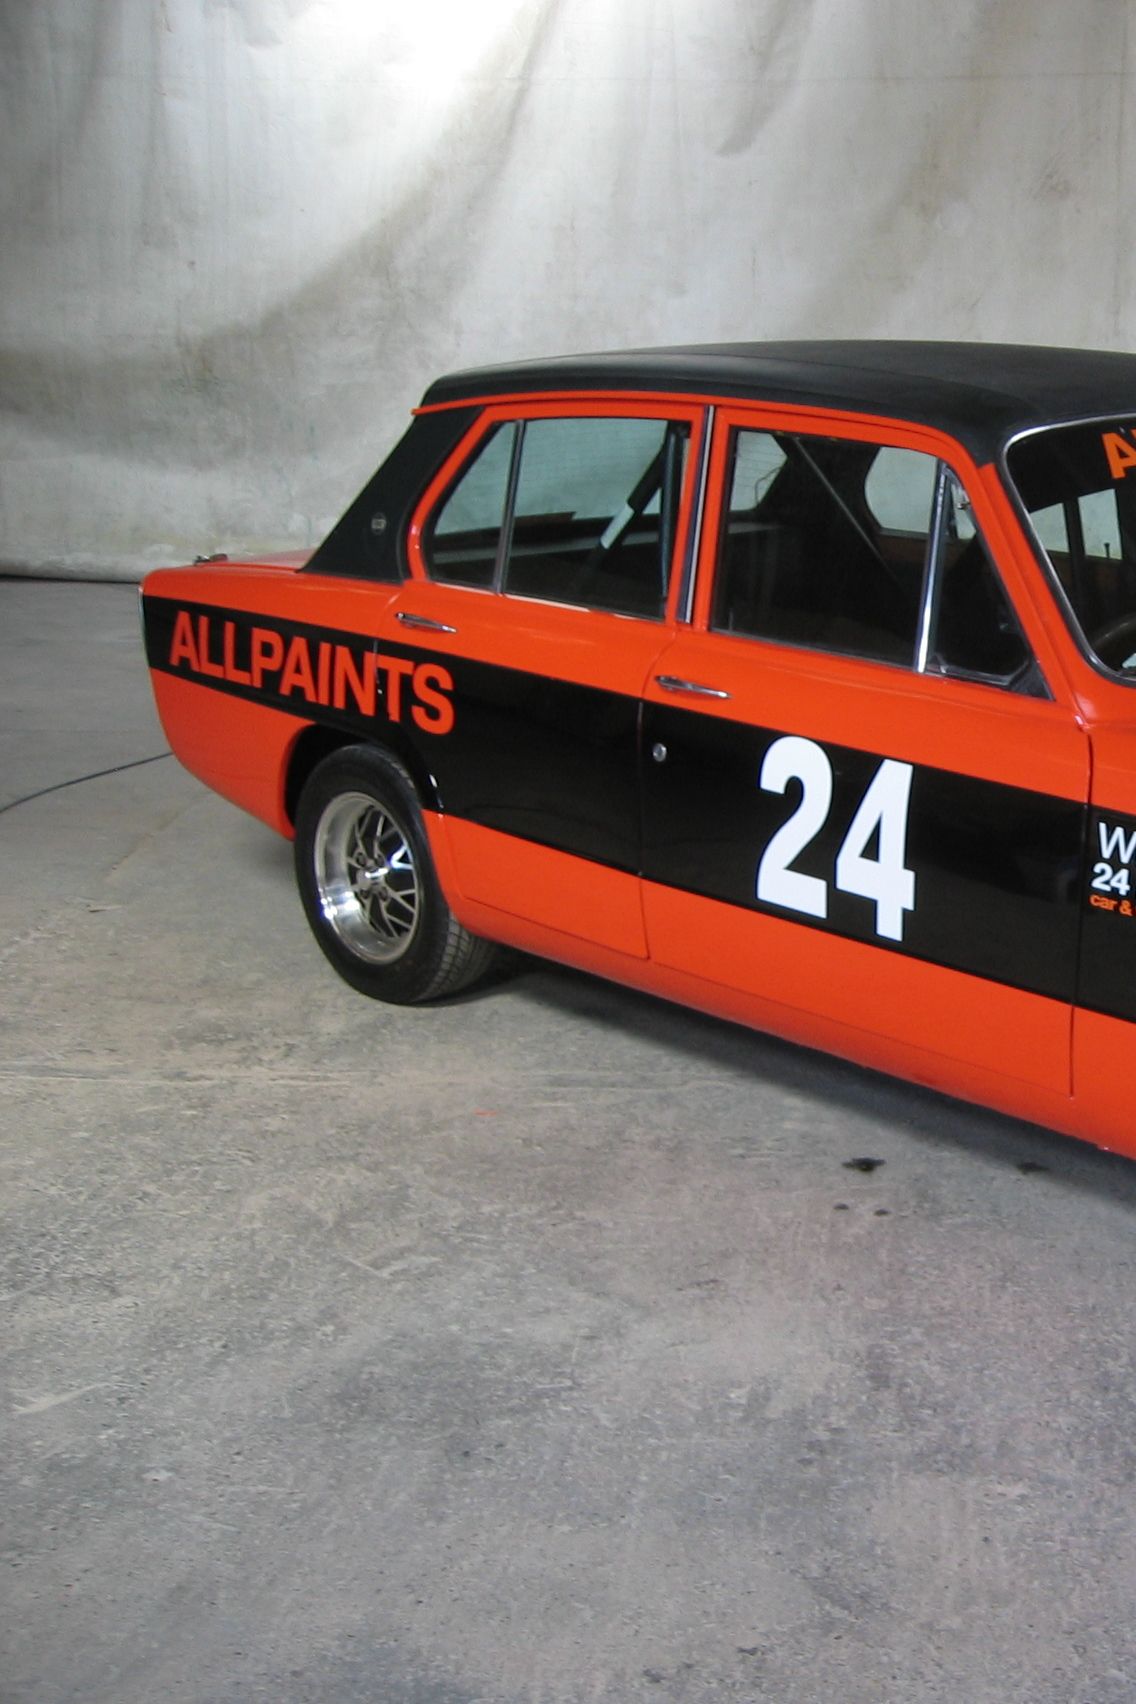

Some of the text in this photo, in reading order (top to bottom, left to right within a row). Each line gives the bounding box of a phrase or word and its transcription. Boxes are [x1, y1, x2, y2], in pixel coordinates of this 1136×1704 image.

[169, 610, 455, 735] ALLPAINTS
[757, 735, 916, 942] 24
[1089, 895, 1118, 911] car
[1119, 899, 1133, 917] &
[1091, 862, 1131, 896] 24
